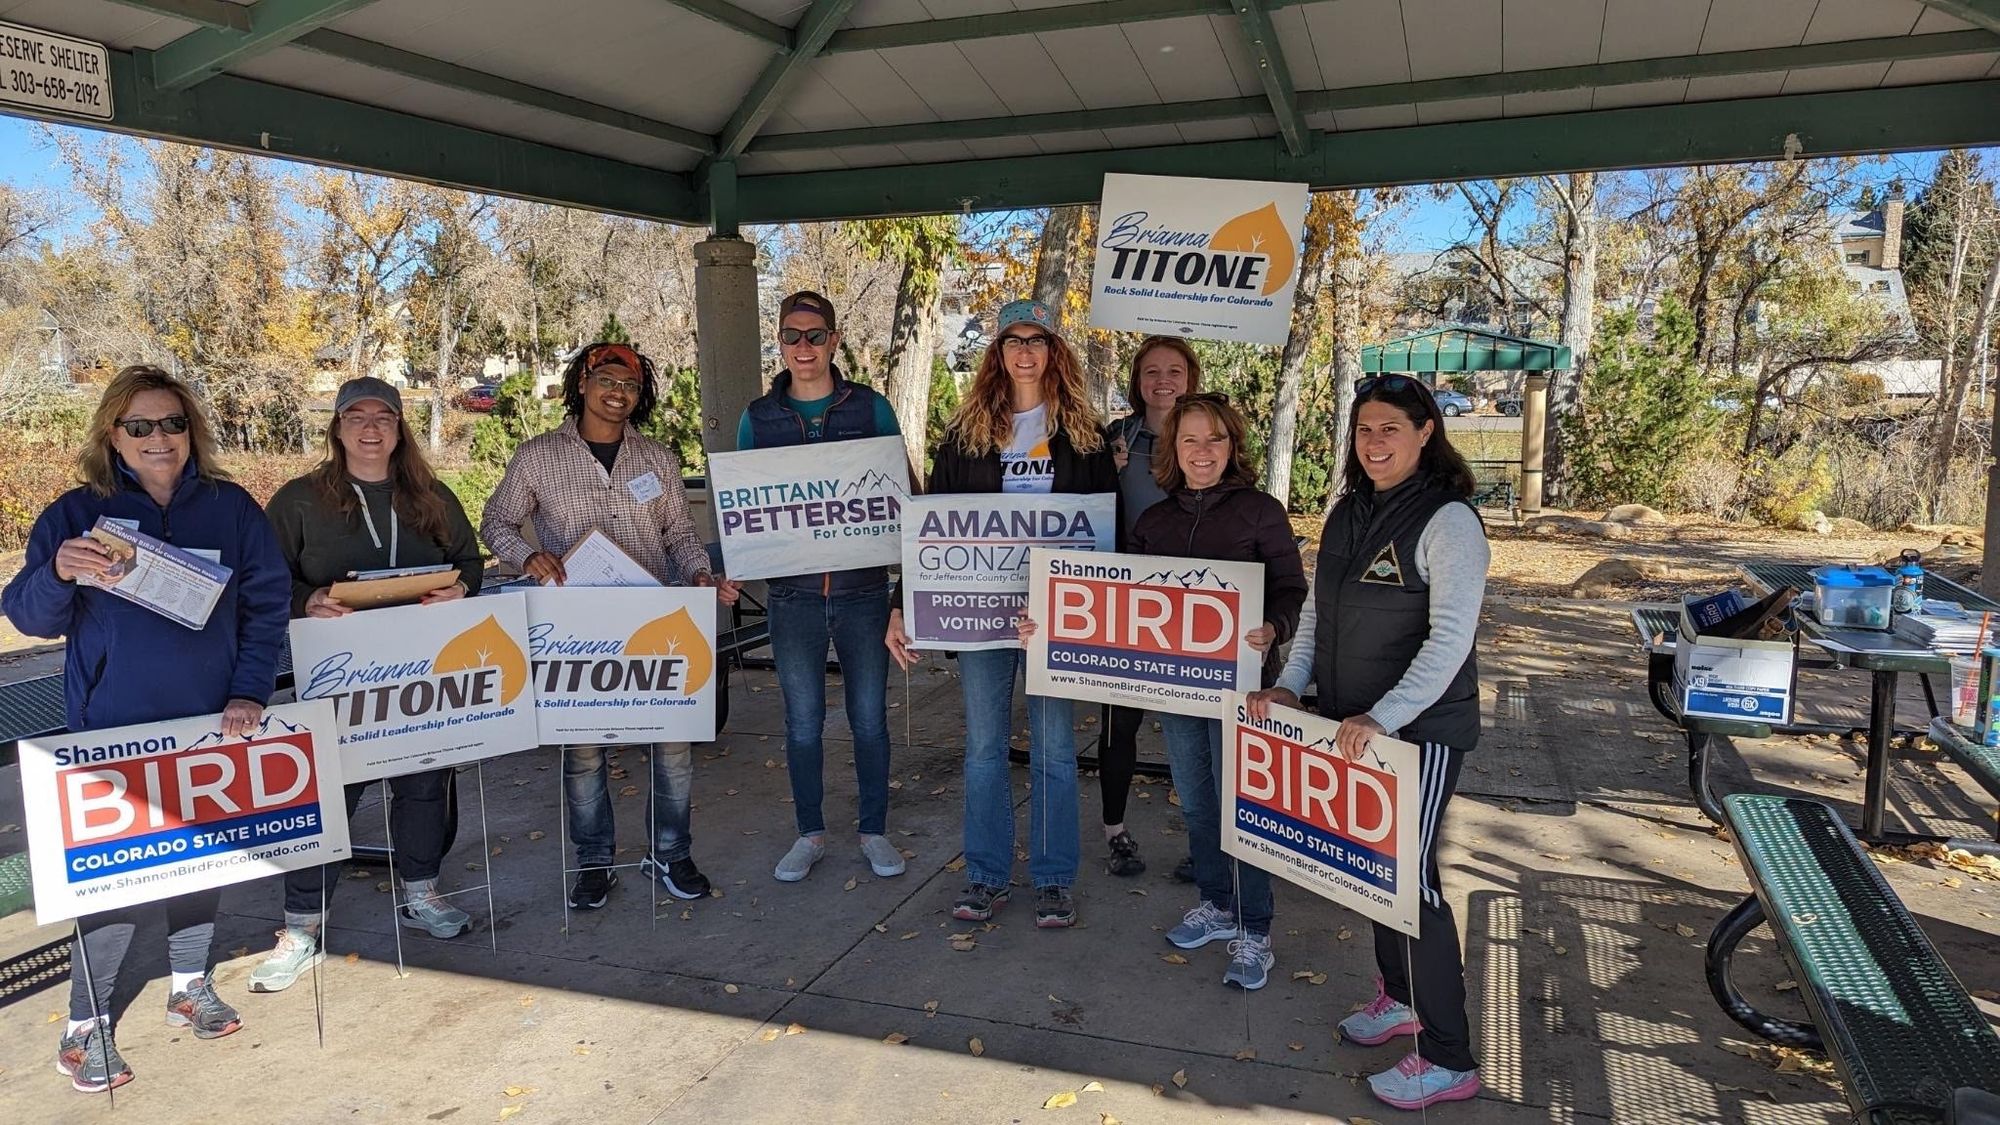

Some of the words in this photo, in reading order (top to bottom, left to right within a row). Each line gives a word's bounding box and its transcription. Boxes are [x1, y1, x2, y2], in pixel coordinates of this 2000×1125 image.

[0, 35, 45, 64] ESERVE
[50, 45, 99, 75] SHELTER
[11, 69, 100, 106] 303-658-2192
[1101, 211, 1211, 248] Brianna
[1111, 247, 1265, 290] TITONE
[1104, 285, 1128, 296] Rock
[1129, 287, 1152, 297] Solid
[1154, 289, 1208, 303] Leadership
[1210, 294, 1225, 304] for
[1227, 295, 1274, 308] Colorado
[1000, 459, 1054, 476] TONE
[719, 479, 840, 509] BRITTANY
[722, 494, 901, 536] PETTERSEN
[814, 529, 838, 540] For
[843, 523, 901, 537] Congres
[919, 510, 1096, 537] AMANDA
[919, 545, 1096, 571] GONZA
[1050, 560, 1132, 581] Shannon
[920, 572, 932, 582] for
[933, 572, 973, 582] Jefferson
[976, 573, 1008, 583] County
[1010, 573, 1029, 582] Cler
[932, 594, 1028, 608] PROTECTIN
[1054, 582, 1234, 653] BIRD
[939, 616, 1005, 630] VOTING
[302, 651, 432, 700] Brianna
[1051, 650, 1130, 669] COLORADO
[1134, 659, 1176, 676] STATE
[1180, 665, 1233, 682] HOUSE
[318, 669, 497, 726] TITONE
[544, 699, 570, 708] Solid
[572, 698, 629, 709] Leadership
[632, 698, 648, 706] for
[650, 697, 696, 706] Colorado
[1050, 674, 1222, 703] www.ShannonBirdForColorado.co
[350, 729, 380, 743] Solid
[382, 719, 444, 738] Leadership
[447, 716, 464, 727] for
[466, 707, 515, 723] Colorado
[55, 733, 177, 767] Shannon
[65, 742, 311, 843] BIRD
[1240, 731, 1393, 843] BIRD
[71, 838, 188, 874] COLORADO
[193, 825, 250, 849] STATE
[255, 813, 317, 837] HOUSE
[1238, 808, 1304, 844] COLORADO
[1307, 835, 1344, 862] STATE
[1347, 851, 1393, 883] HOUSE
[74, 839, 320, 897] www.ShannonBirdForColorado.com
[1237, 834, 1393, 909] www.ShannonBirdForColorado.com
